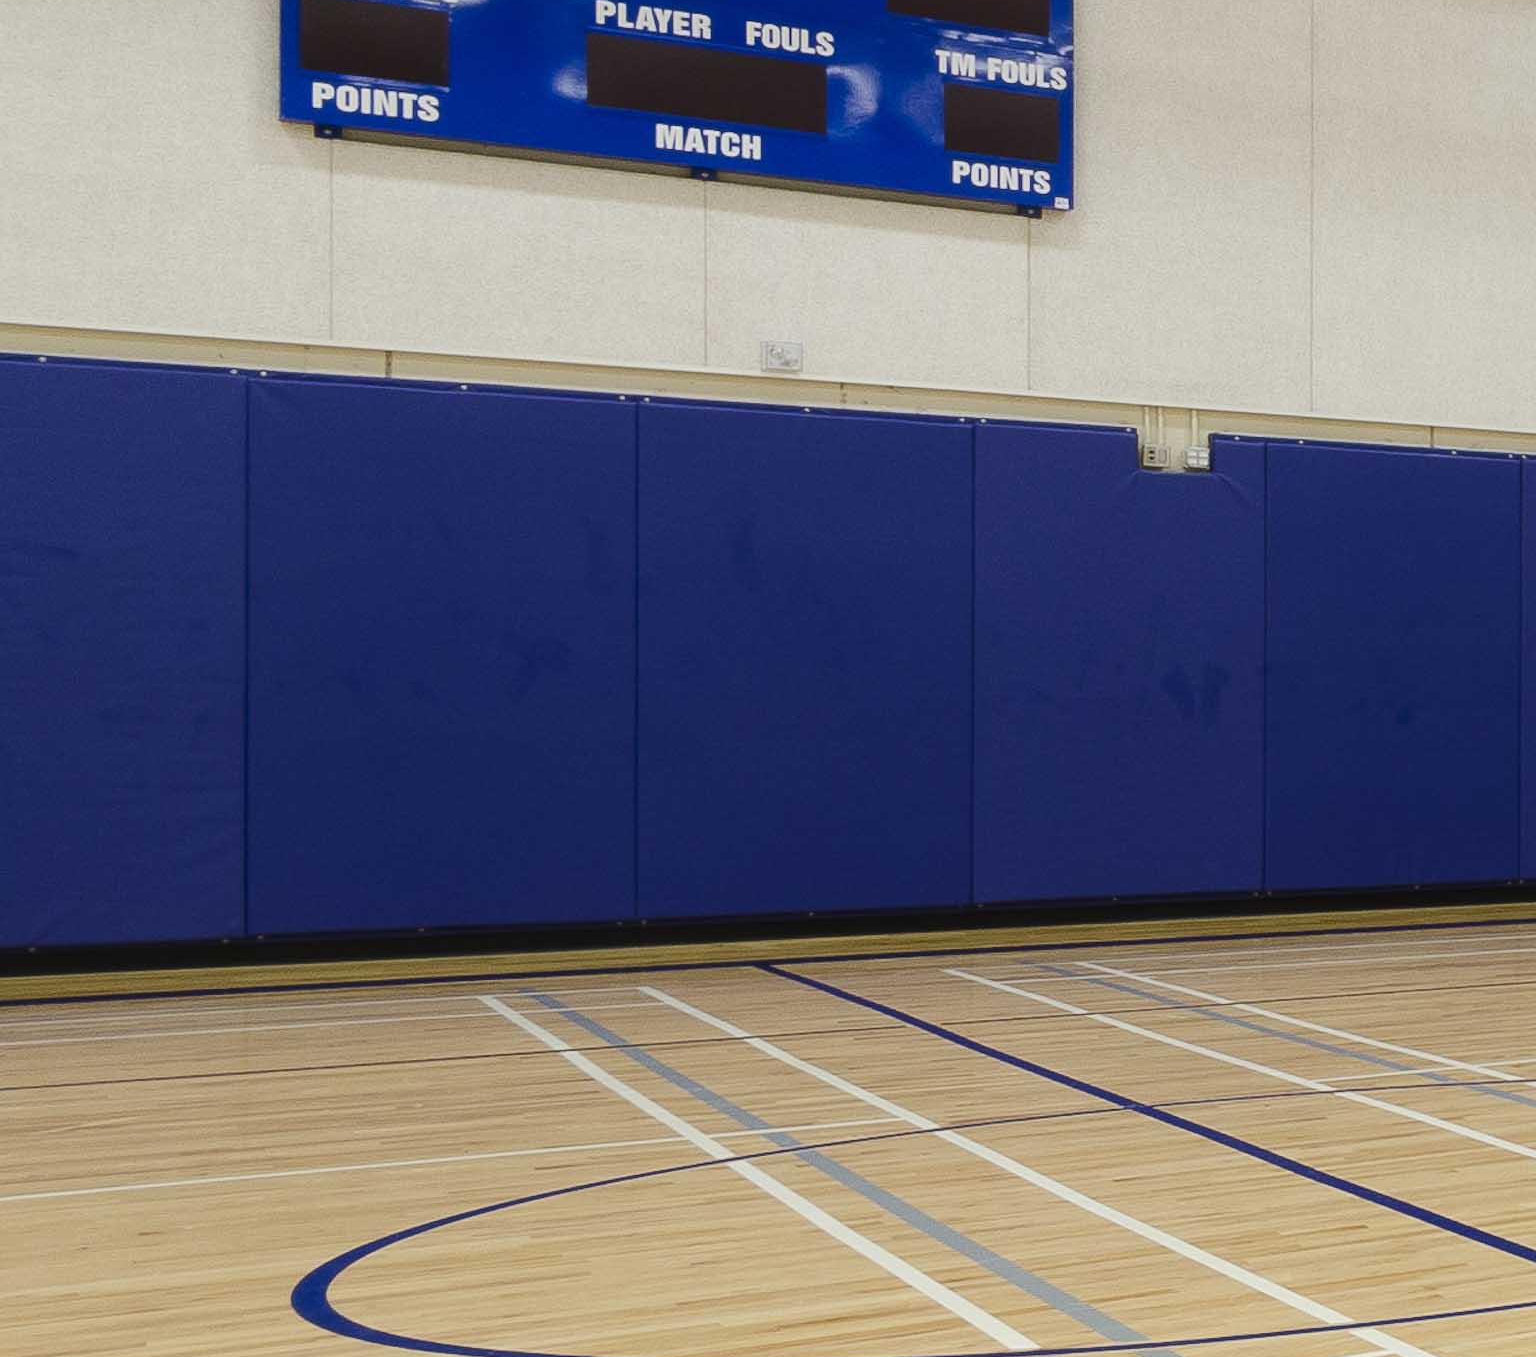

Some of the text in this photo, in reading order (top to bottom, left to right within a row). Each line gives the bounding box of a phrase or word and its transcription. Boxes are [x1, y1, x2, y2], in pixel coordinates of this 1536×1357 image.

[595, 0, 835, 58] PLAYER FOULS
[935, 49, 1068, 91] TM FOULS
[311, 82, 440, 122] POINTS
[655, 123, 762, 161] MATCH
[952, 160, 1051, 195] POINTS
